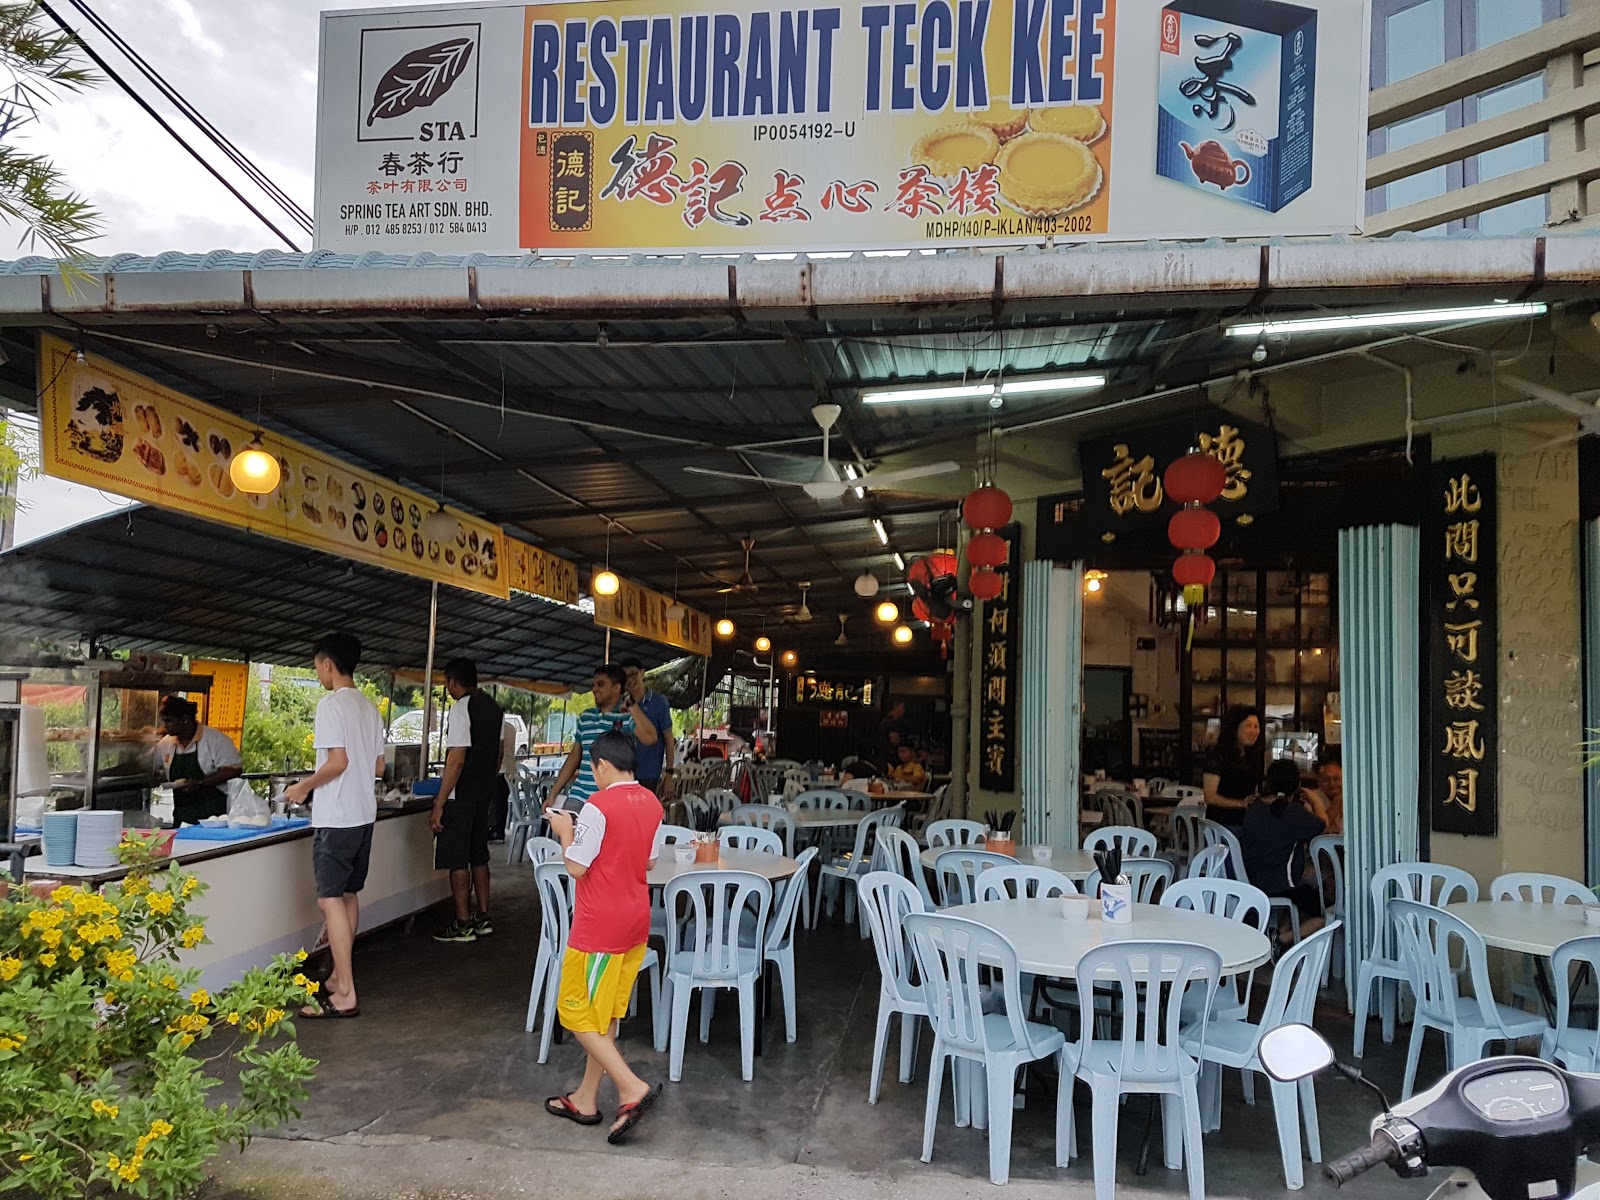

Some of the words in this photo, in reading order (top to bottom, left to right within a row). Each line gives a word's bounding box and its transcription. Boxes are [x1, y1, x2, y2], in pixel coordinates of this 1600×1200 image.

[530, 7, 841, 125] RESTAURANT
[861, 0, 991, 111] TECK
[1011, 0, 1105, 105] KEE
[419, 121, 466, 141] STA
[753, 121, 856, 141] IP0054192-U
[377, 150, 465, 177] 春茶行
[366, 178, 469, 195] 茶叶有限公司
[340, 204, 382, 220] SPRING
[385, 203, 406, 218] TEA
[409, 202, 431, 218] ART
[434, 201, 461, 217] SDN.
[465, 201, 493, 217] BHD.
[365, 224, 380, 235] 012
[385, 223, 400, 235] 485
[402, 223, 422, 234] 8253
[429, 222, 445, 234] 012
[449, 222, 464, 233] 584
[466, 221, 487, 233] 0413
